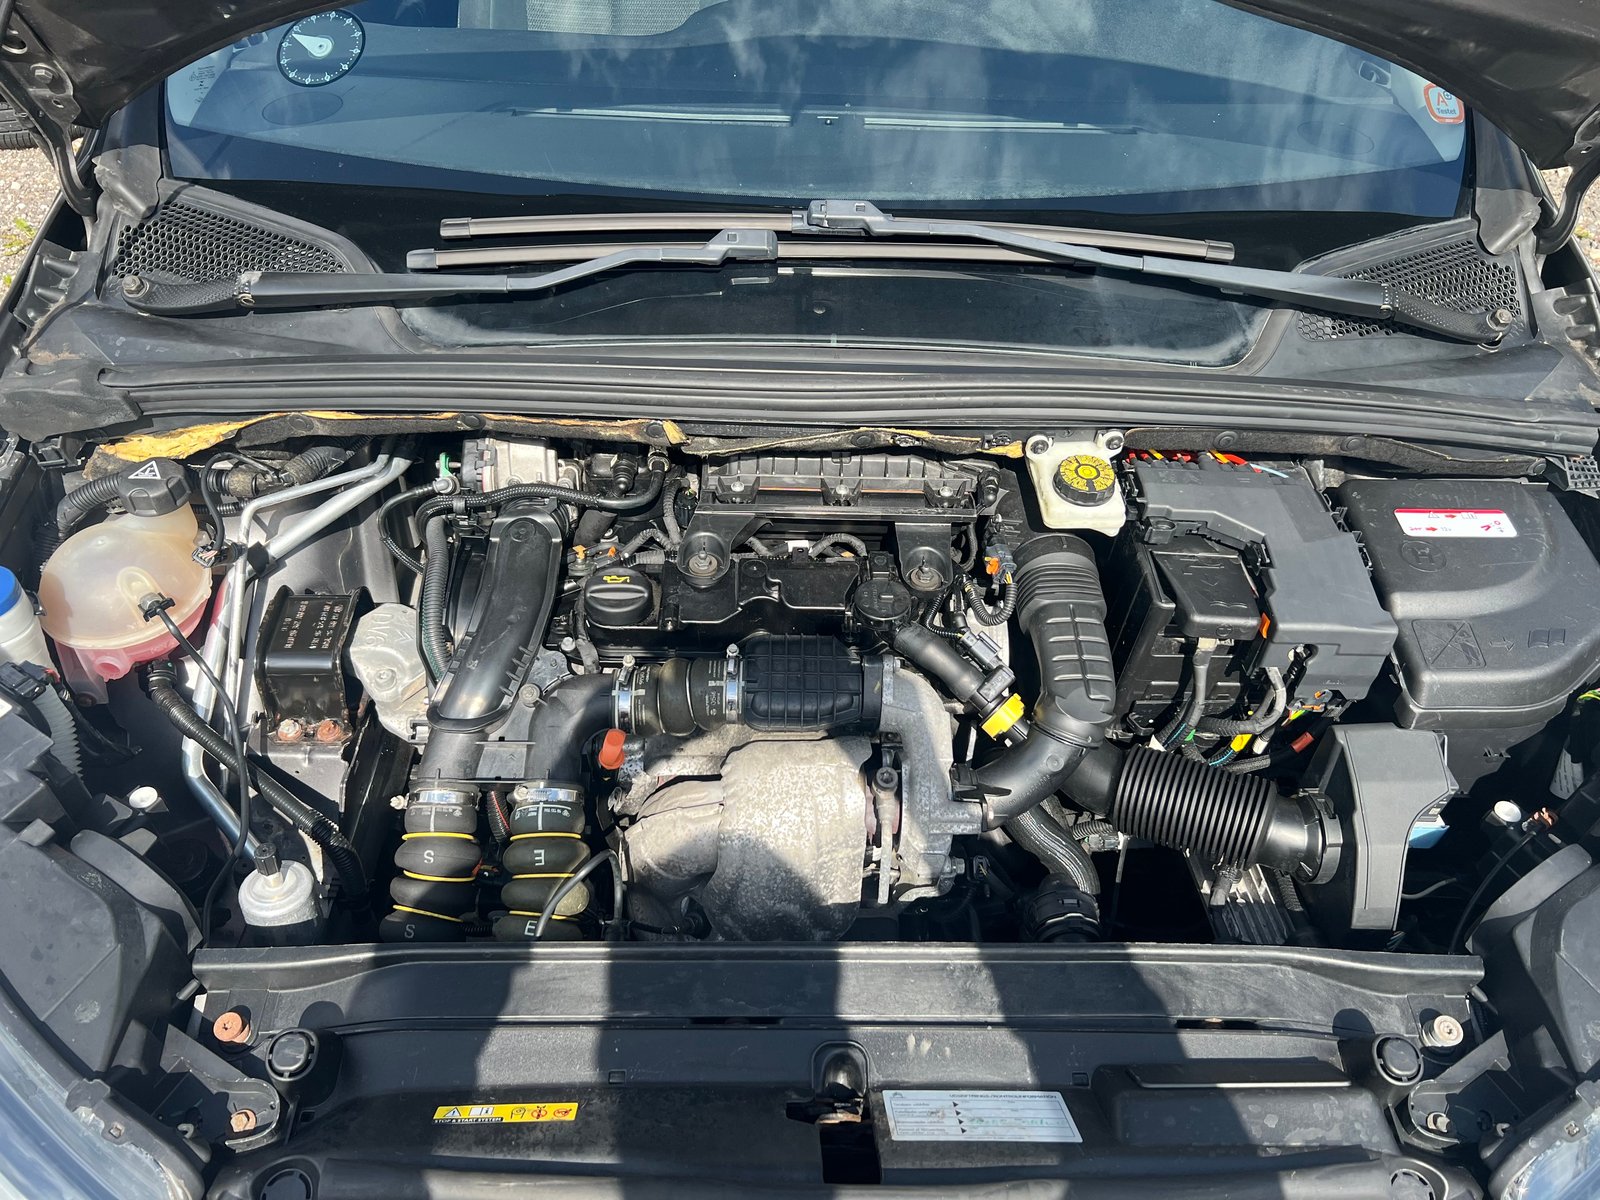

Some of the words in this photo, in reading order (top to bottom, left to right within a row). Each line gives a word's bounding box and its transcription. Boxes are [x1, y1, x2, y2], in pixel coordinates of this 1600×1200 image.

[365, 613, 393, 647] DV6
[423, 850, 435, 864] S
[533, 849, 546, 866] E
[404, 924, 416, 939] S
[524, 920, 538, 936] E
